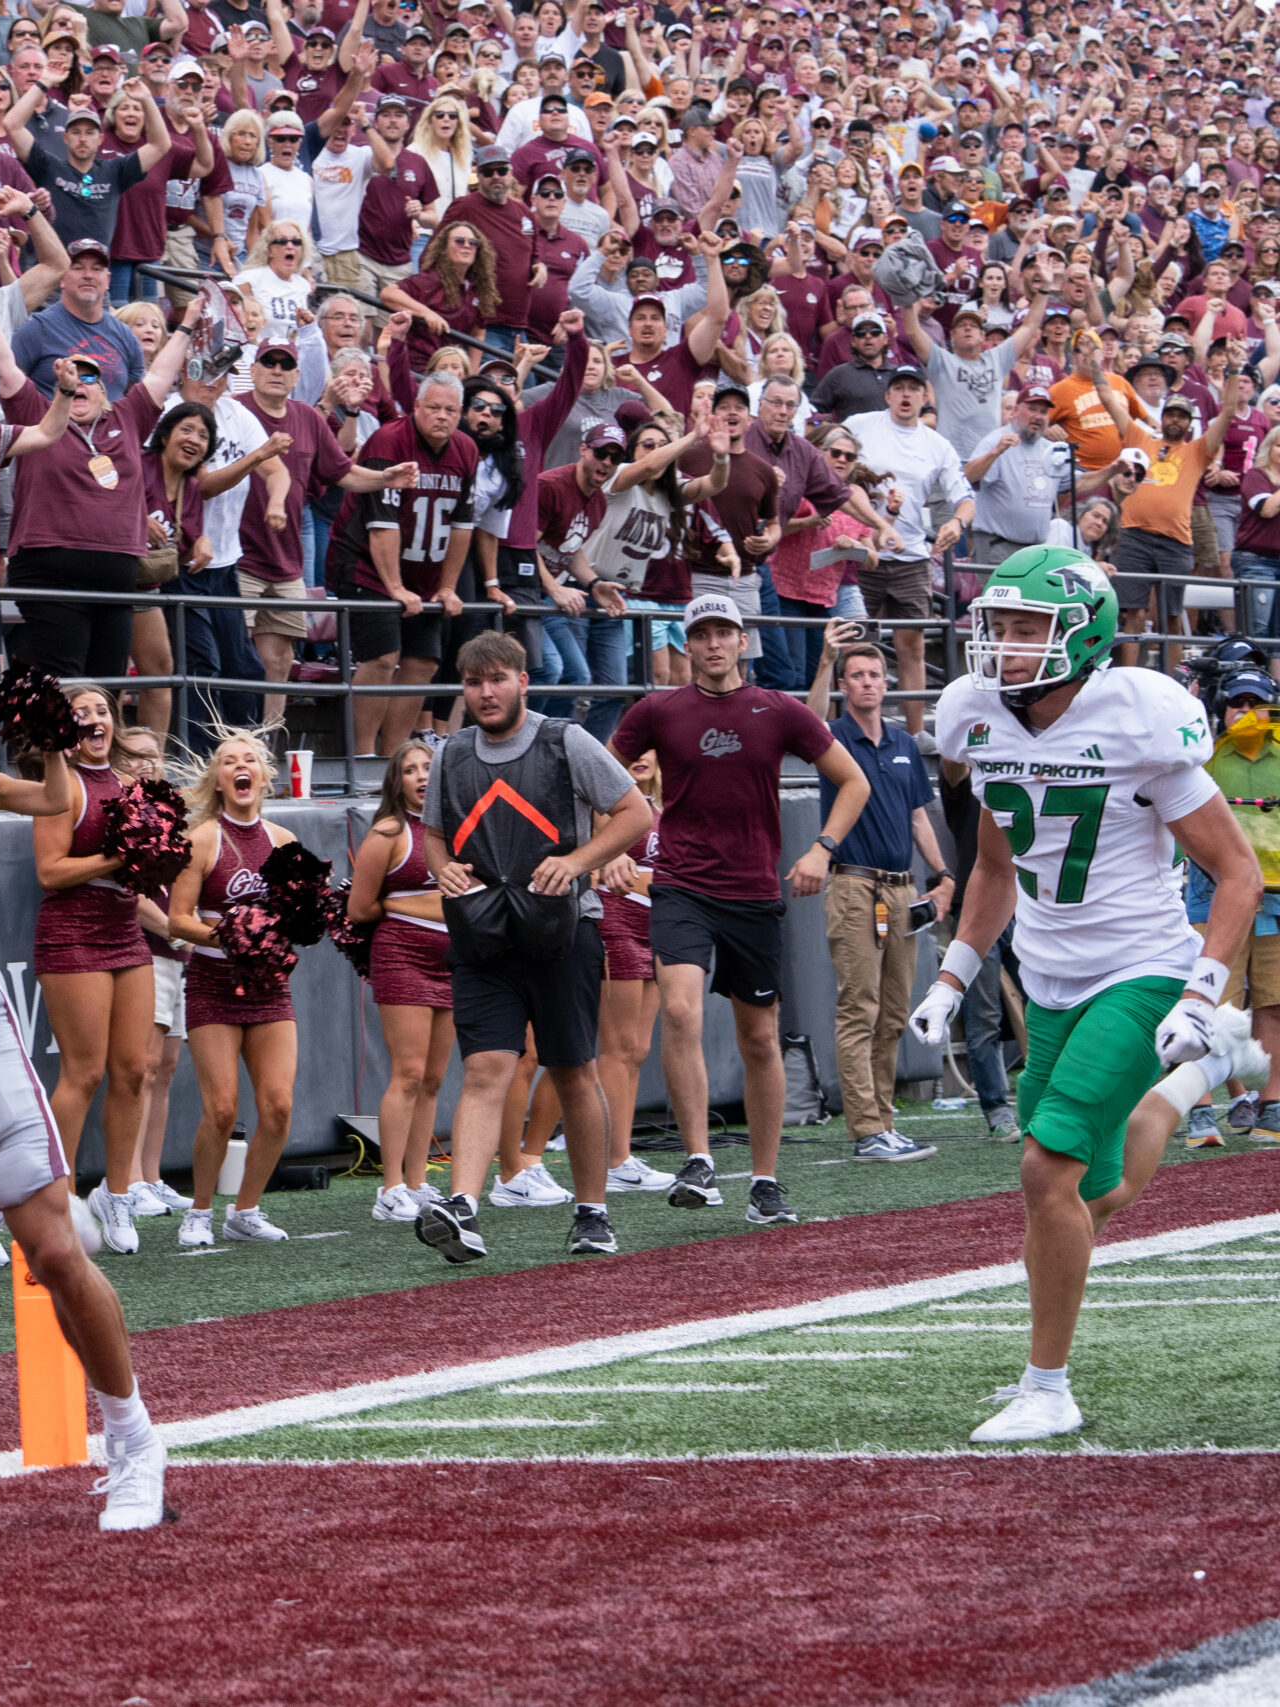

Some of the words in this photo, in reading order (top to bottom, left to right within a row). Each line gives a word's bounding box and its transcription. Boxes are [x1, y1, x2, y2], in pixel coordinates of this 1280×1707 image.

[416, 473, 462, 492] ONTAN
[402, 496, 455, 563] 16
[991, 588, 1009, 598] 701
[691, 602, 727, 616] MARIAS
[699, 728, 742, 757] Griz
[976, 761, 1024, 776] NORTH
[1028, 763, 1106, 779] DAKOTA
[984, 782, 1110, 904] 27
[224, 869, 270, 903] Gr
